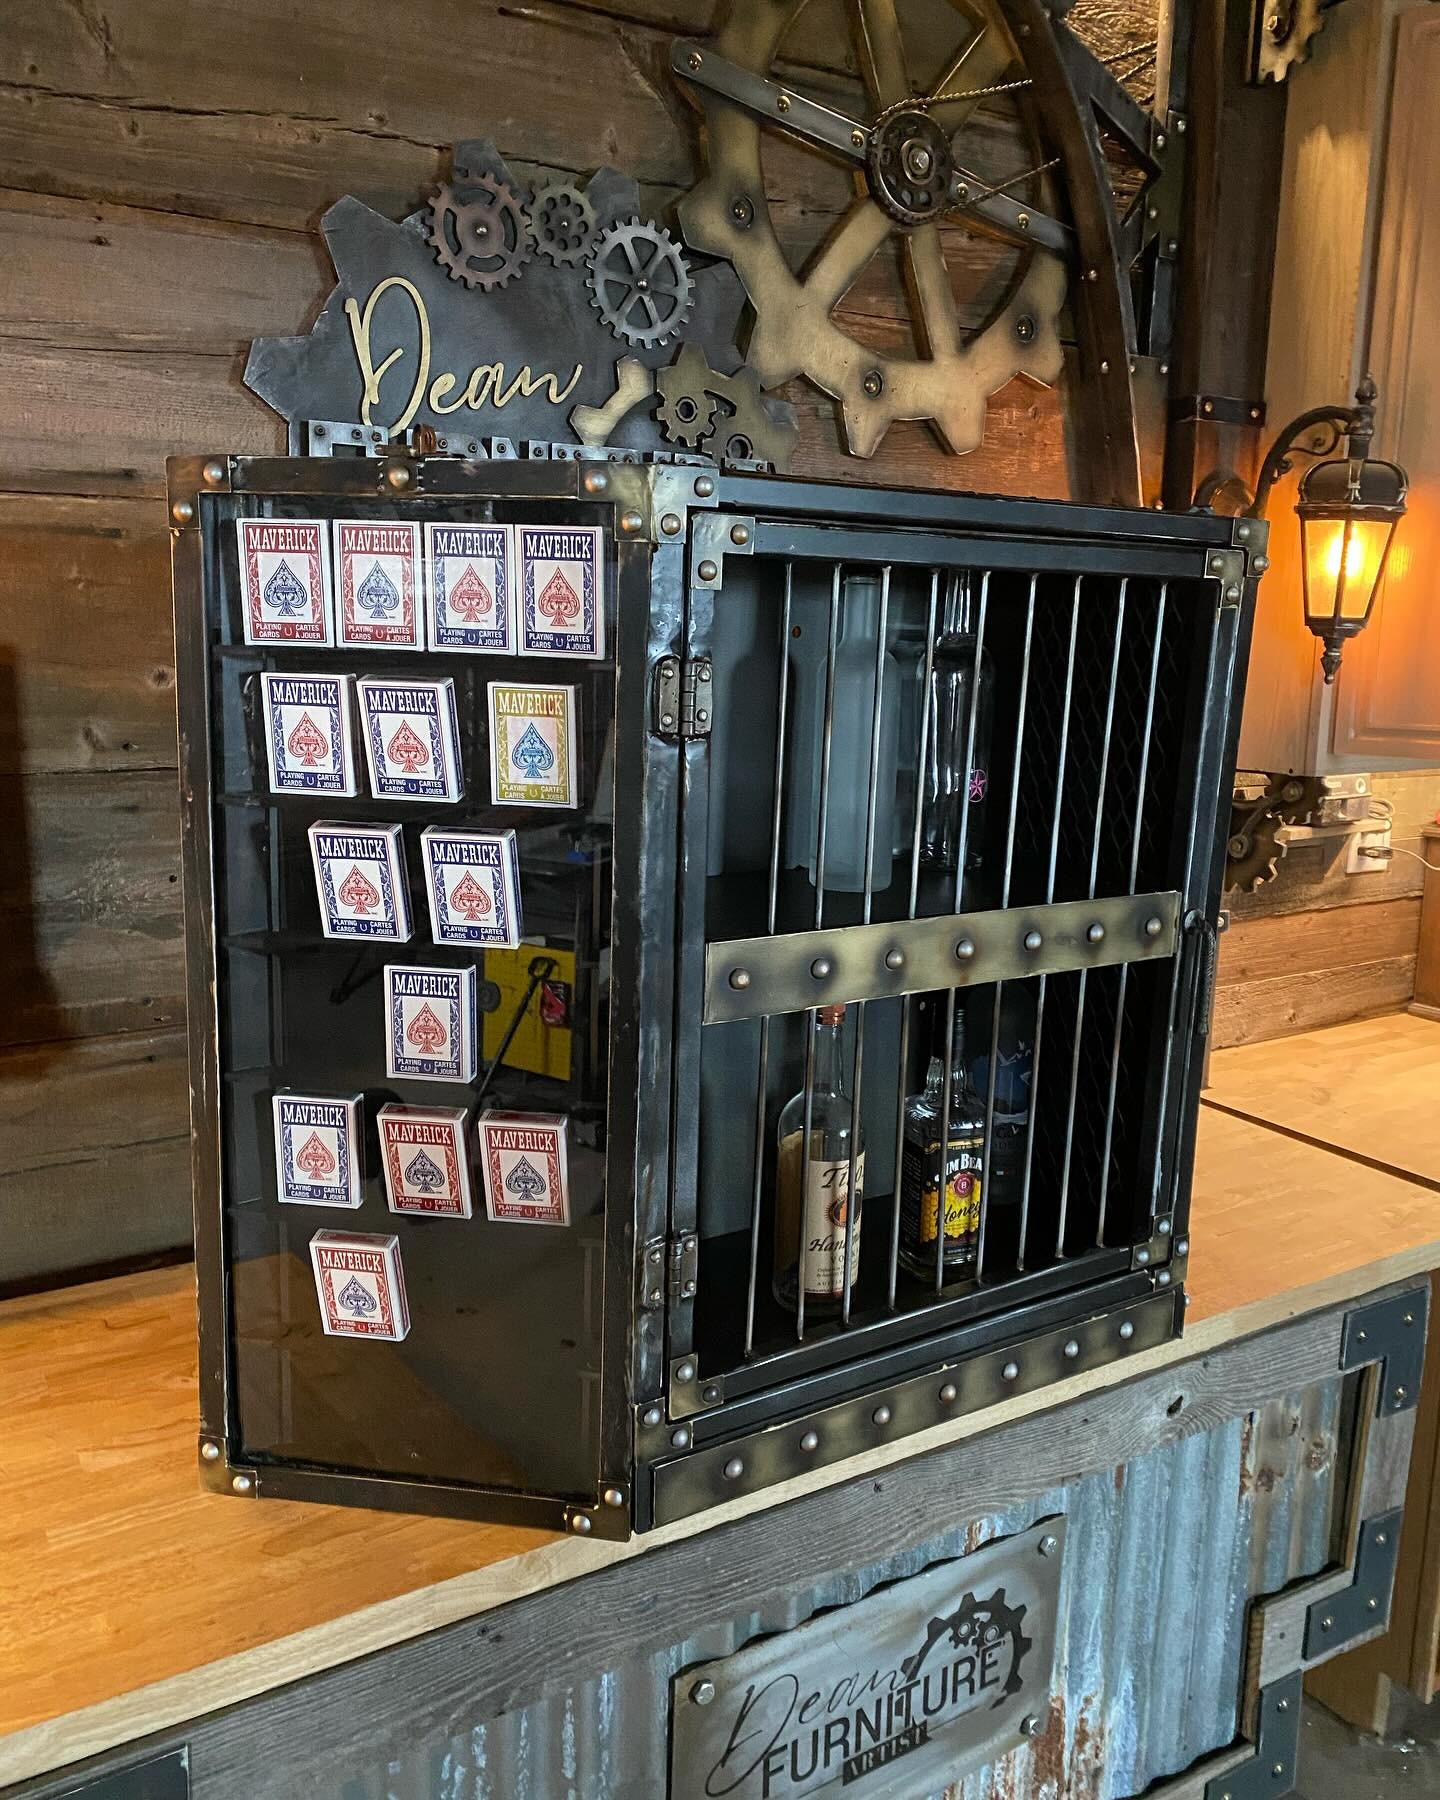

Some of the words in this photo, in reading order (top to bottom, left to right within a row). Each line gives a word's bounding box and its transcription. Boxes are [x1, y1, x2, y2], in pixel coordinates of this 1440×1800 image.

[344, 276, 583, 437] Dean
[249, 528, 316, 551] MAVERICK
[345, 529, 409, 552] MAVERICK
[436, 532, 502, 556] MAVERICK
[526, 535, 591, 558] MAVERICK
[256, 623, 282, 631] PLAYING
[296, 624, 320, 632] CARTES
[348, 624, 373, 633] PLAYING
[531, 641, 551, 649] CARDS
[272, 682, 336, 704] MAVERICK
[368, 691, 435, 712] MAVERICK
[499, 692, 563, 715] MAVERICK
[382, 778, 406, 786] PLAYING
[419, 780, 442, 788] CARTES
[319, 838, 385, 858] MAVERICK
[433, 843, 498, 864] MAVERICK
[333, 919, 358, 927] PLAYING
[370, 921, 392, 929] CARTES
[395, 974, 457, 996] MAVERICK
[283, 1104, 344, 1126] MAVERICK
[388, 1124, 451, 1144] MAVERICK
[490, 1130, 554, 1150] MAVERICK
[321, 1251, 382, 1271] MAVERICK
[705, 1656, 918, 1797] Dean
[762, 1641, 1002, 1799] FURNITURE
